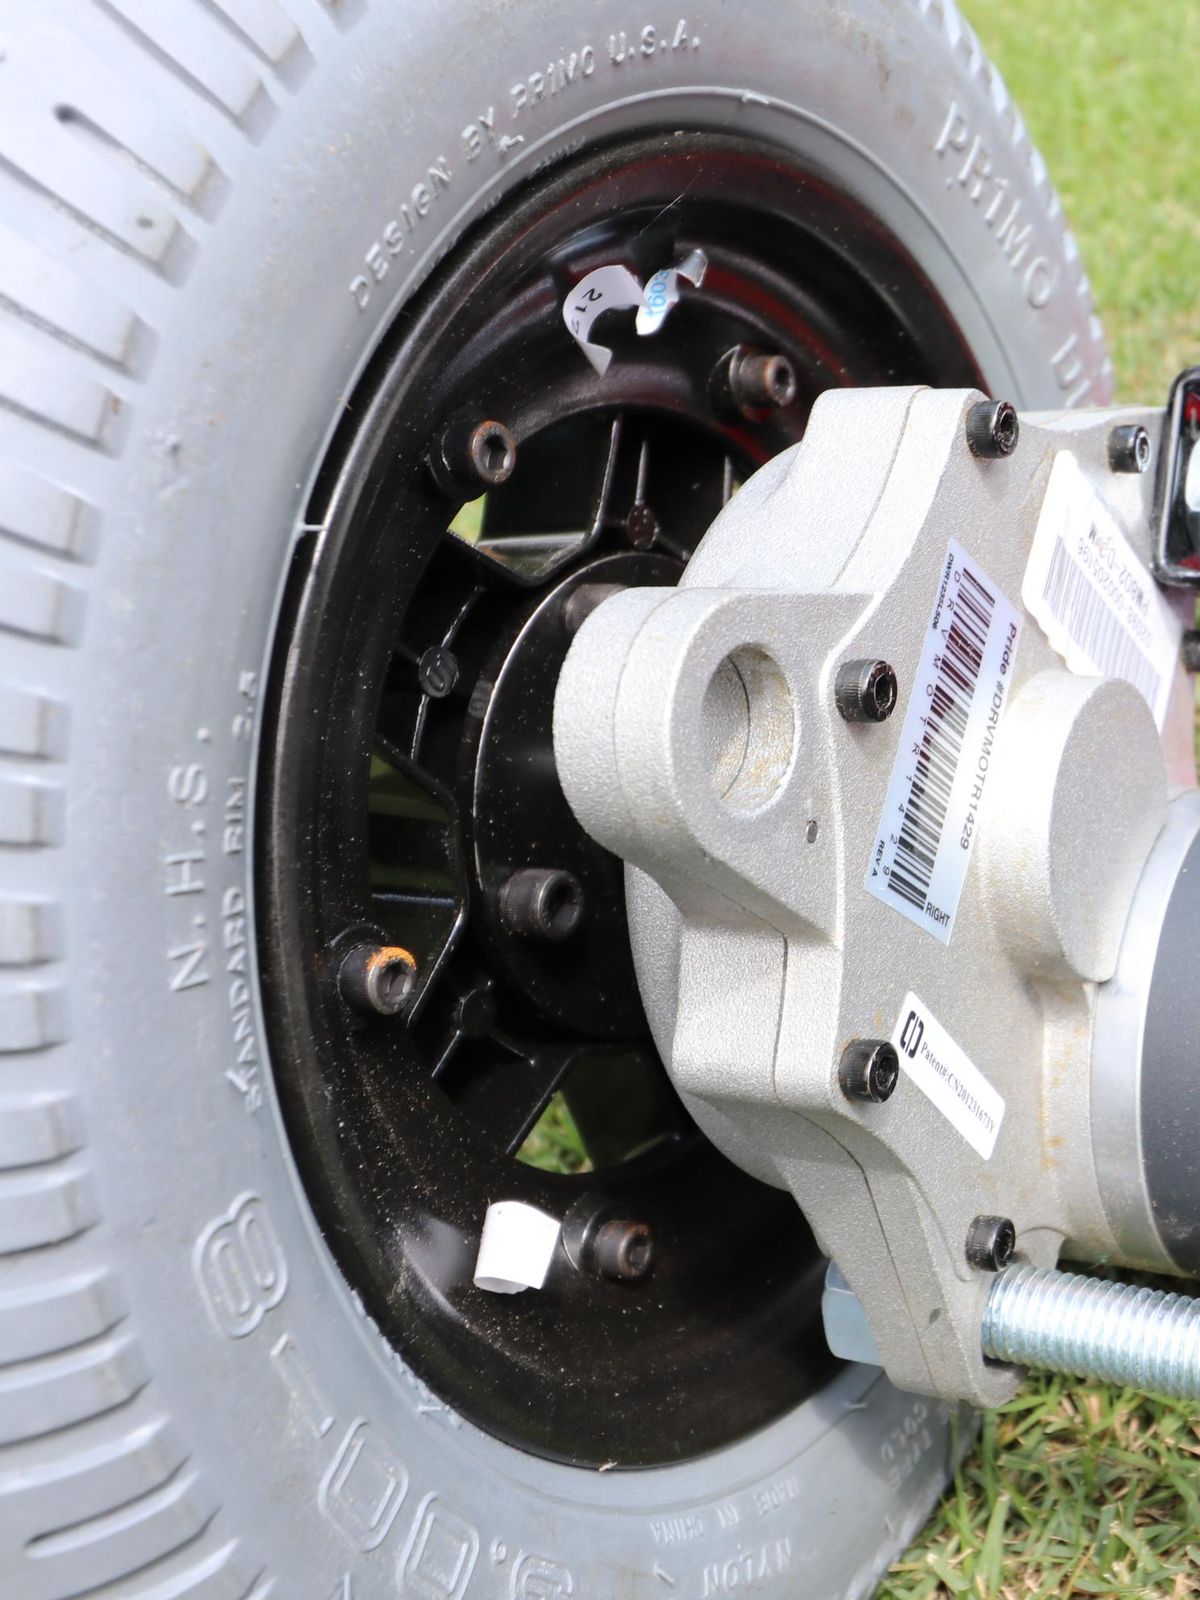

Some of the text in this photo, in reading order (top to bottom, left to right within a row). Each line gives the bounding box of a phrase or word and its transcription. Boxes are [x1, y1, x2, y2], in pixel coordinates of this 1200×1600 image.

[350, 155, 452, 310] DESIGN
[462, 106, 495, 162] BY
[609, 18, 700, 65] U.S.A.
[1000, 621, 1017, 676] Pride
[222, 777, 246, 855] RIM
[165, 726, 211, 992] N.H.S.
[874, 839, 886, 867] REV
[925, 901, 951, 928] RIGHT
[222, 886, 262, 1112] STANDARD
[702, 1537, 792, 1599] NYLON
